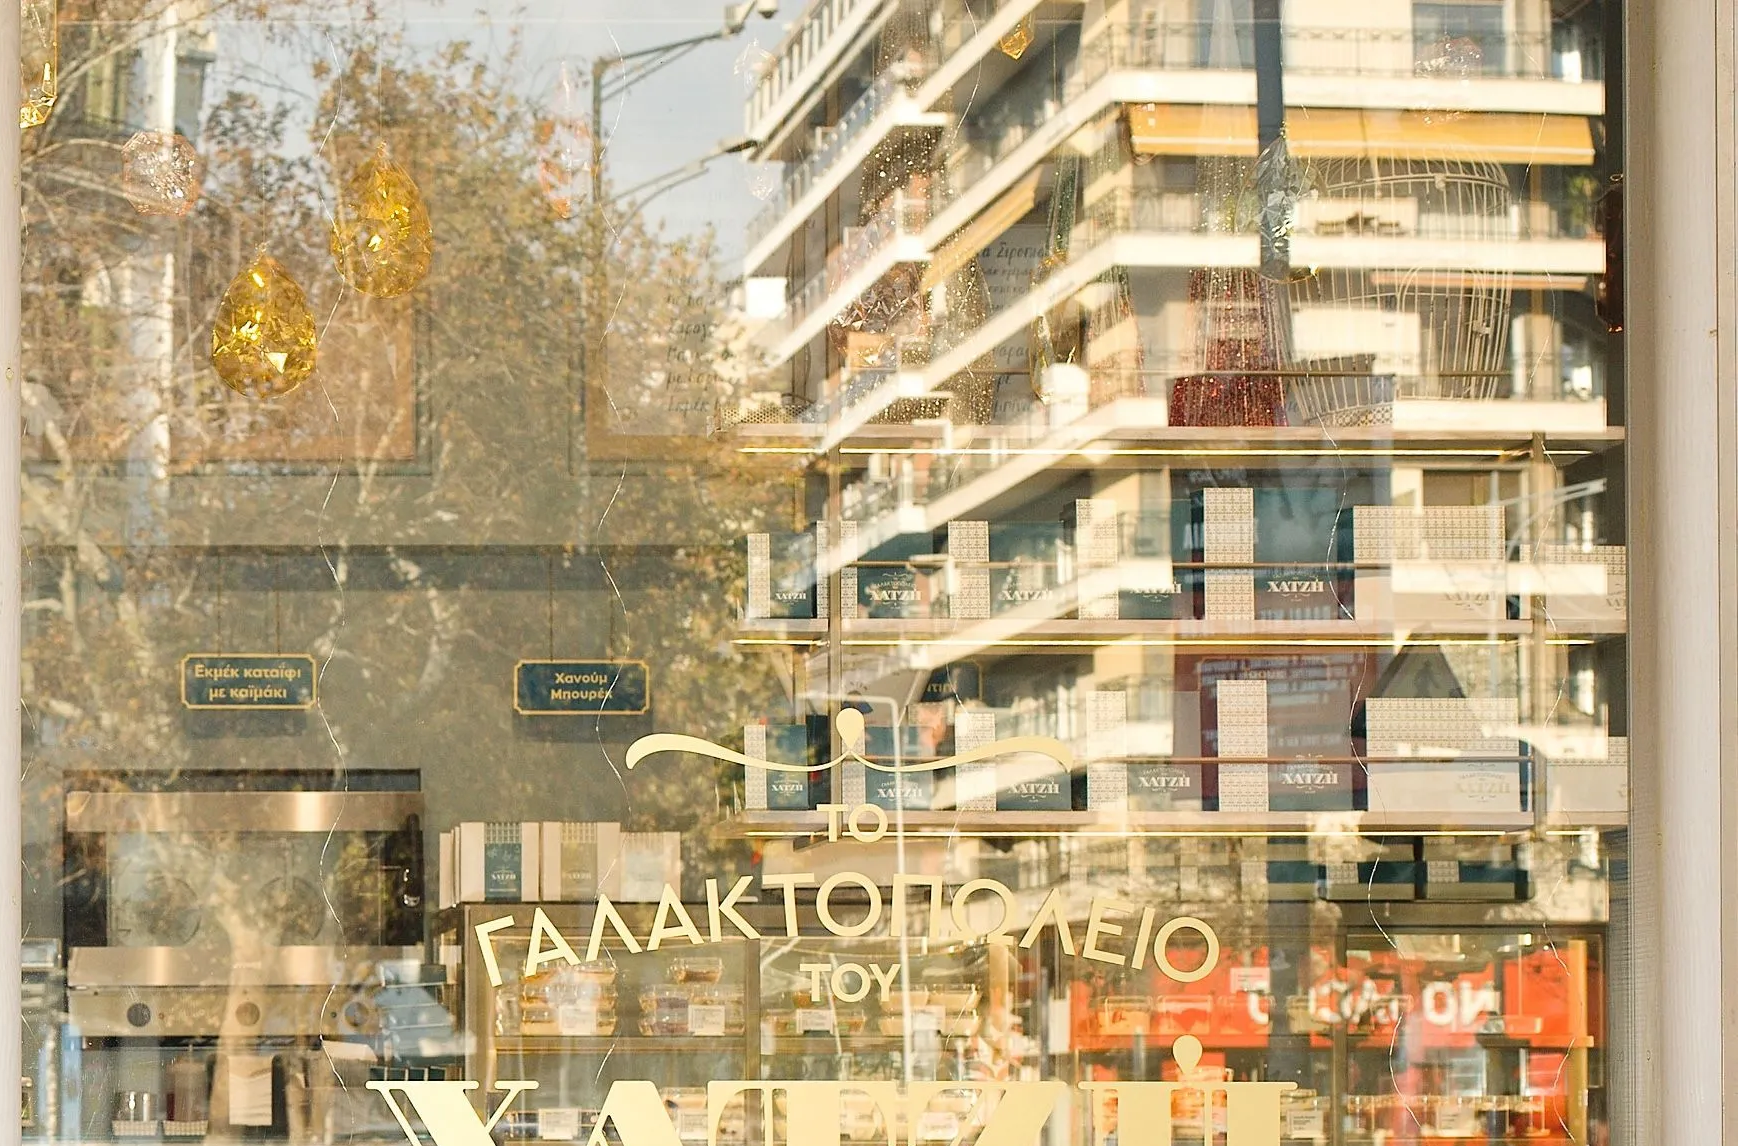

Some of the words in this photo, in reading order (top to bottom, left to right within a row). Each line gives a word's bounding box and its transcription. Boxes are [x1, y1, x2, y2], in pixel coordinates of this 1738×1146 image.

[194, 664, 239, 681] Εκμέκ
[555, 672, 608, 685] Χανούμ
[209, 687, 225, 701] με
[230, 685, 287, 701] καϊμάκι
[816, 803, 889, 844] ΤΟ
[473, 871, 1220, 988] ΓΑΛΑΚΤΟΠΩΛΕΙΟ
[799, 962, 902, 1003] ΤΟΥ
